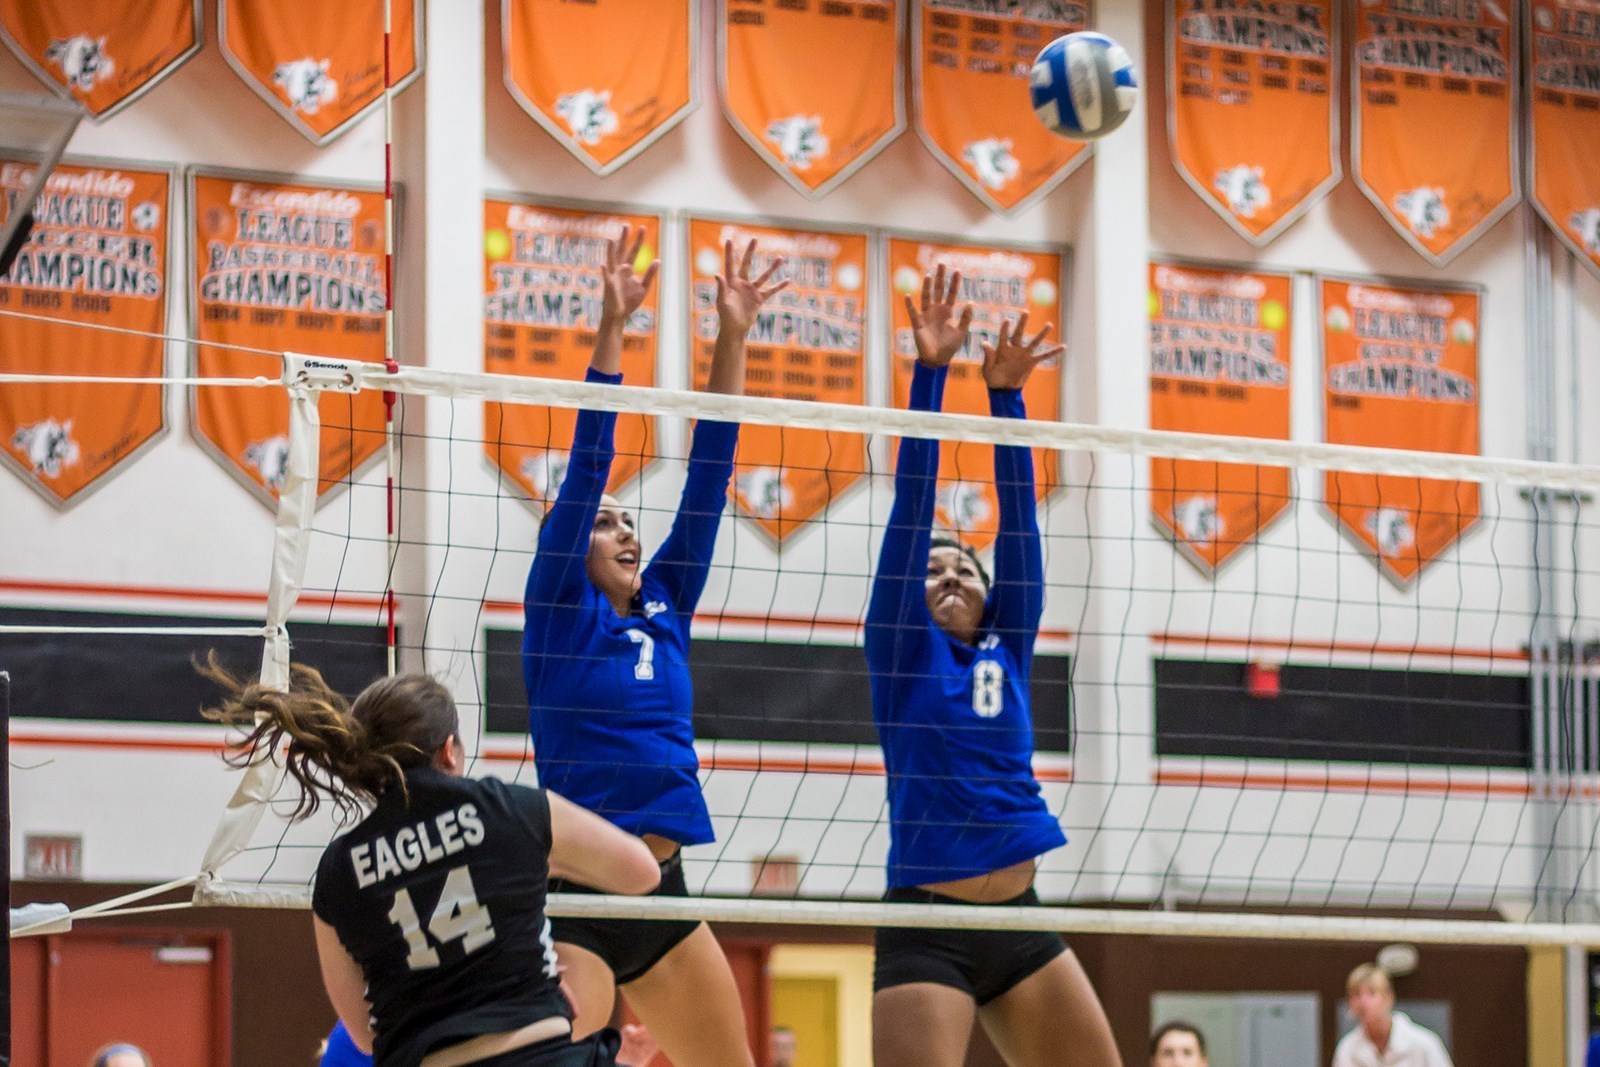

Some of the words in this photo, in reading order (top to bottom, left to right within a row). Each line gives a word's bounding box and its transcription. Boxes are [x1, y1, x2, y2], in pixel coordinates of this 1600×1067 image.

[237, 208, 353, 248] LEAGUE
[515, 232, 606, 268] LEAGU
[0, 250, 161, 296] AMPIONS
[201, 270, 386, 313] CHAMPIONS
[495, 267, 603, 291] TENN
[485, 291, 653, 332] CHAMPIS
[700, 311, 859, 350] CMPIONS
[1150, 347, 1287, 385] HAMPIONS
[623, 628, 654, 680] 7
[972, 659, 1004, 718] 8
[350, 803, 485, 889] EAGLES
[388, 864, 495, 971] 14
